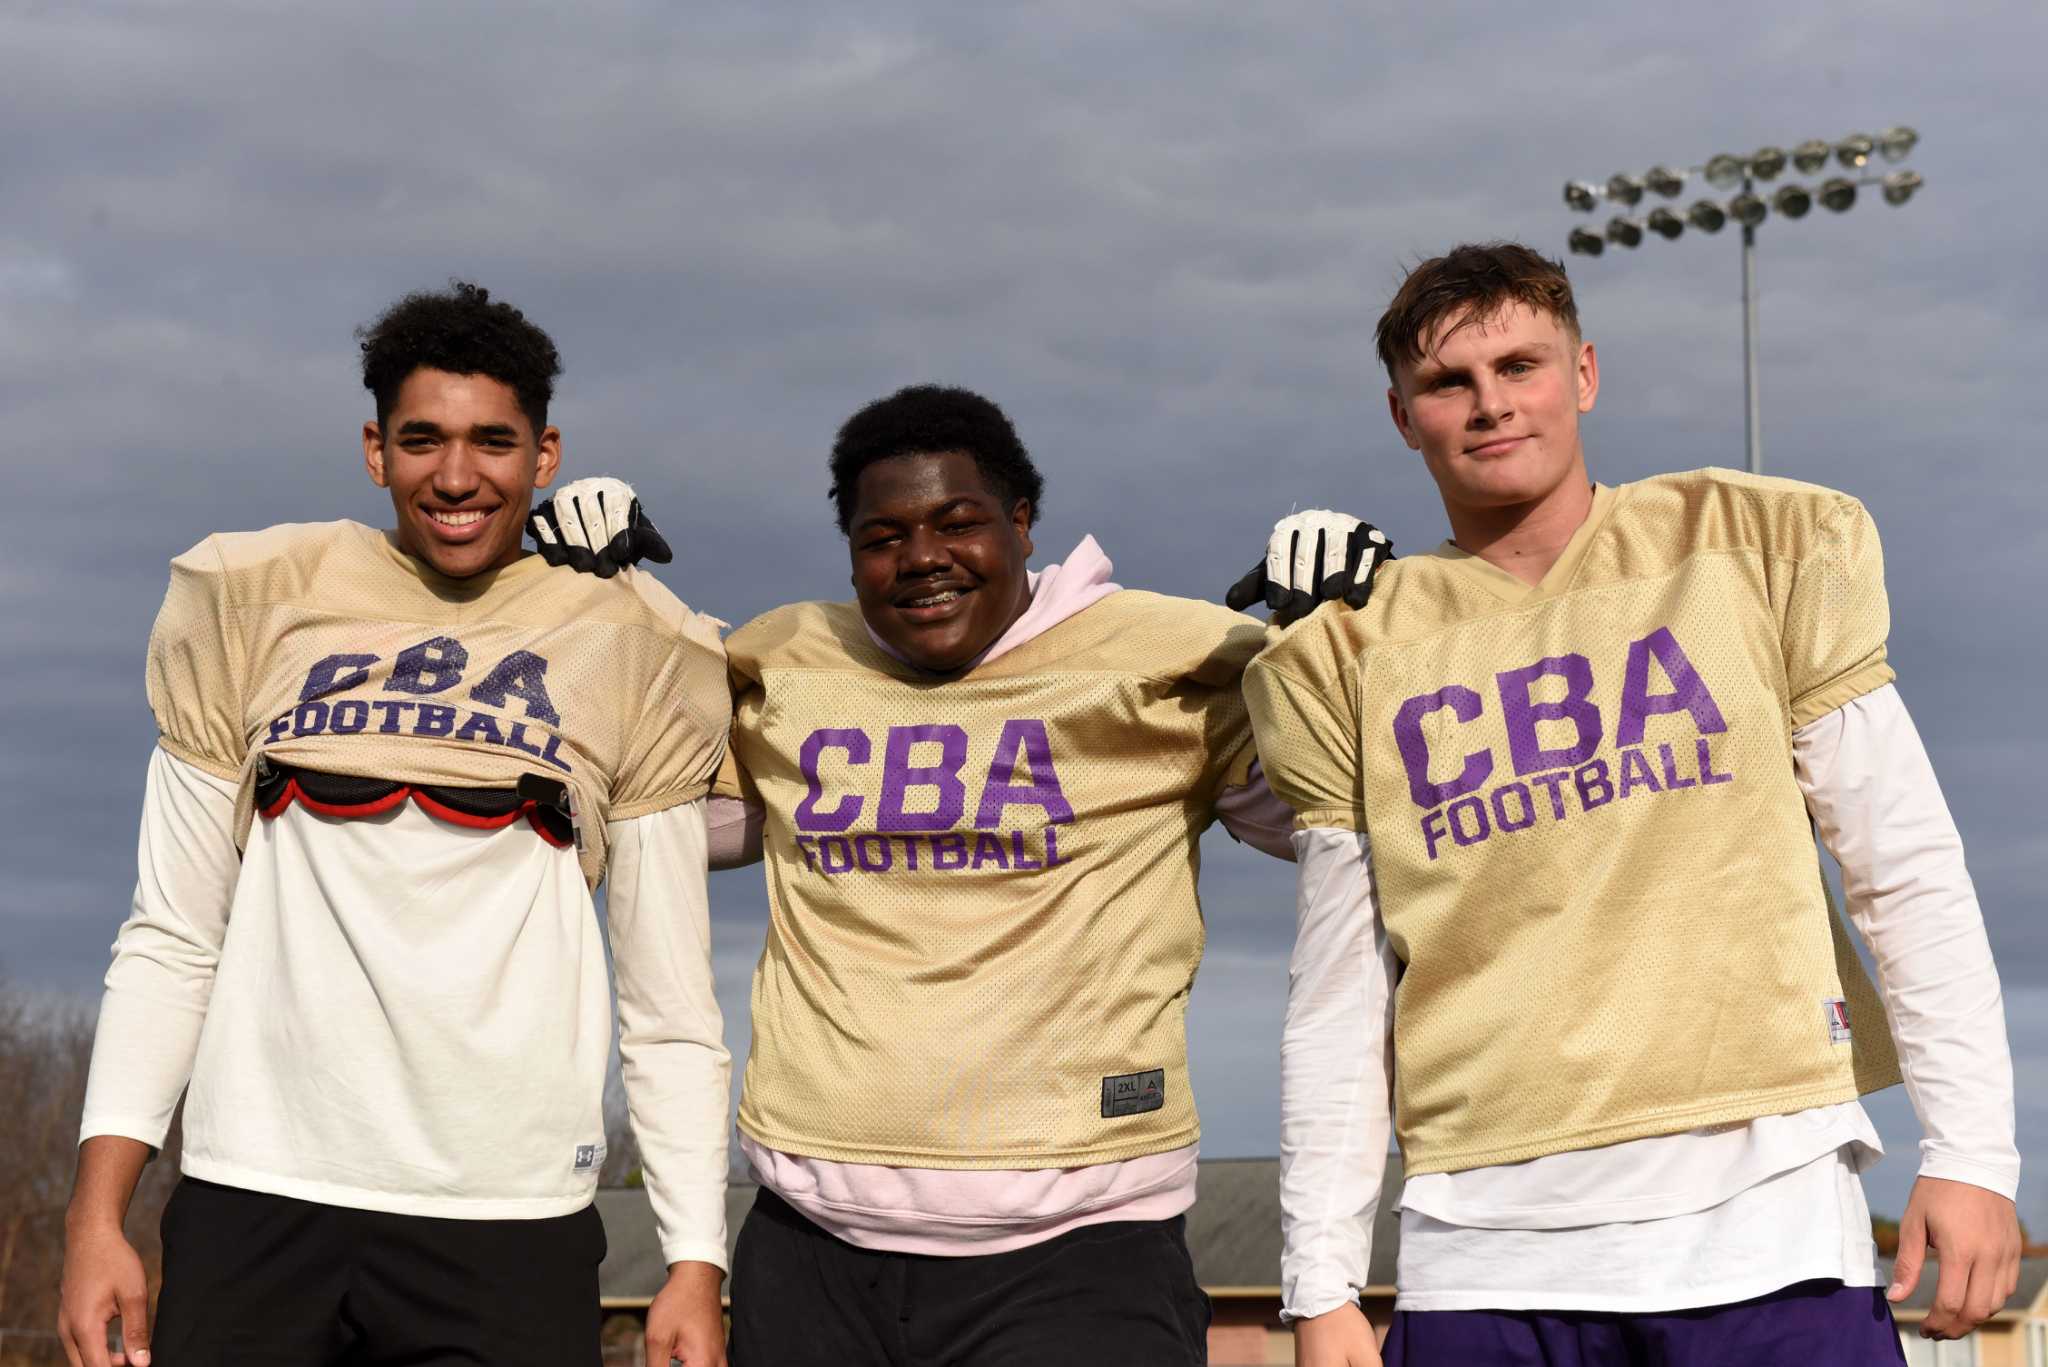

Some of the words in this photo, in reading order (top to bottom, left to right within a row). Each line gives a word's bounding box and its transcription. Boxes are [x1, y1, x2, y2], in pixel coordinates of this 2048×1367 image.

[297, 636, 560, 729] CBA
[1393, 626, 1728, 810] CBA
[264, 700, 573, 773] FOOTBALL
[794, 719, 1075, 832] CBA
[795, 826, 1073, 874] FOOTBALL
[1420, 738, 1733, 861] FOOTBALL
